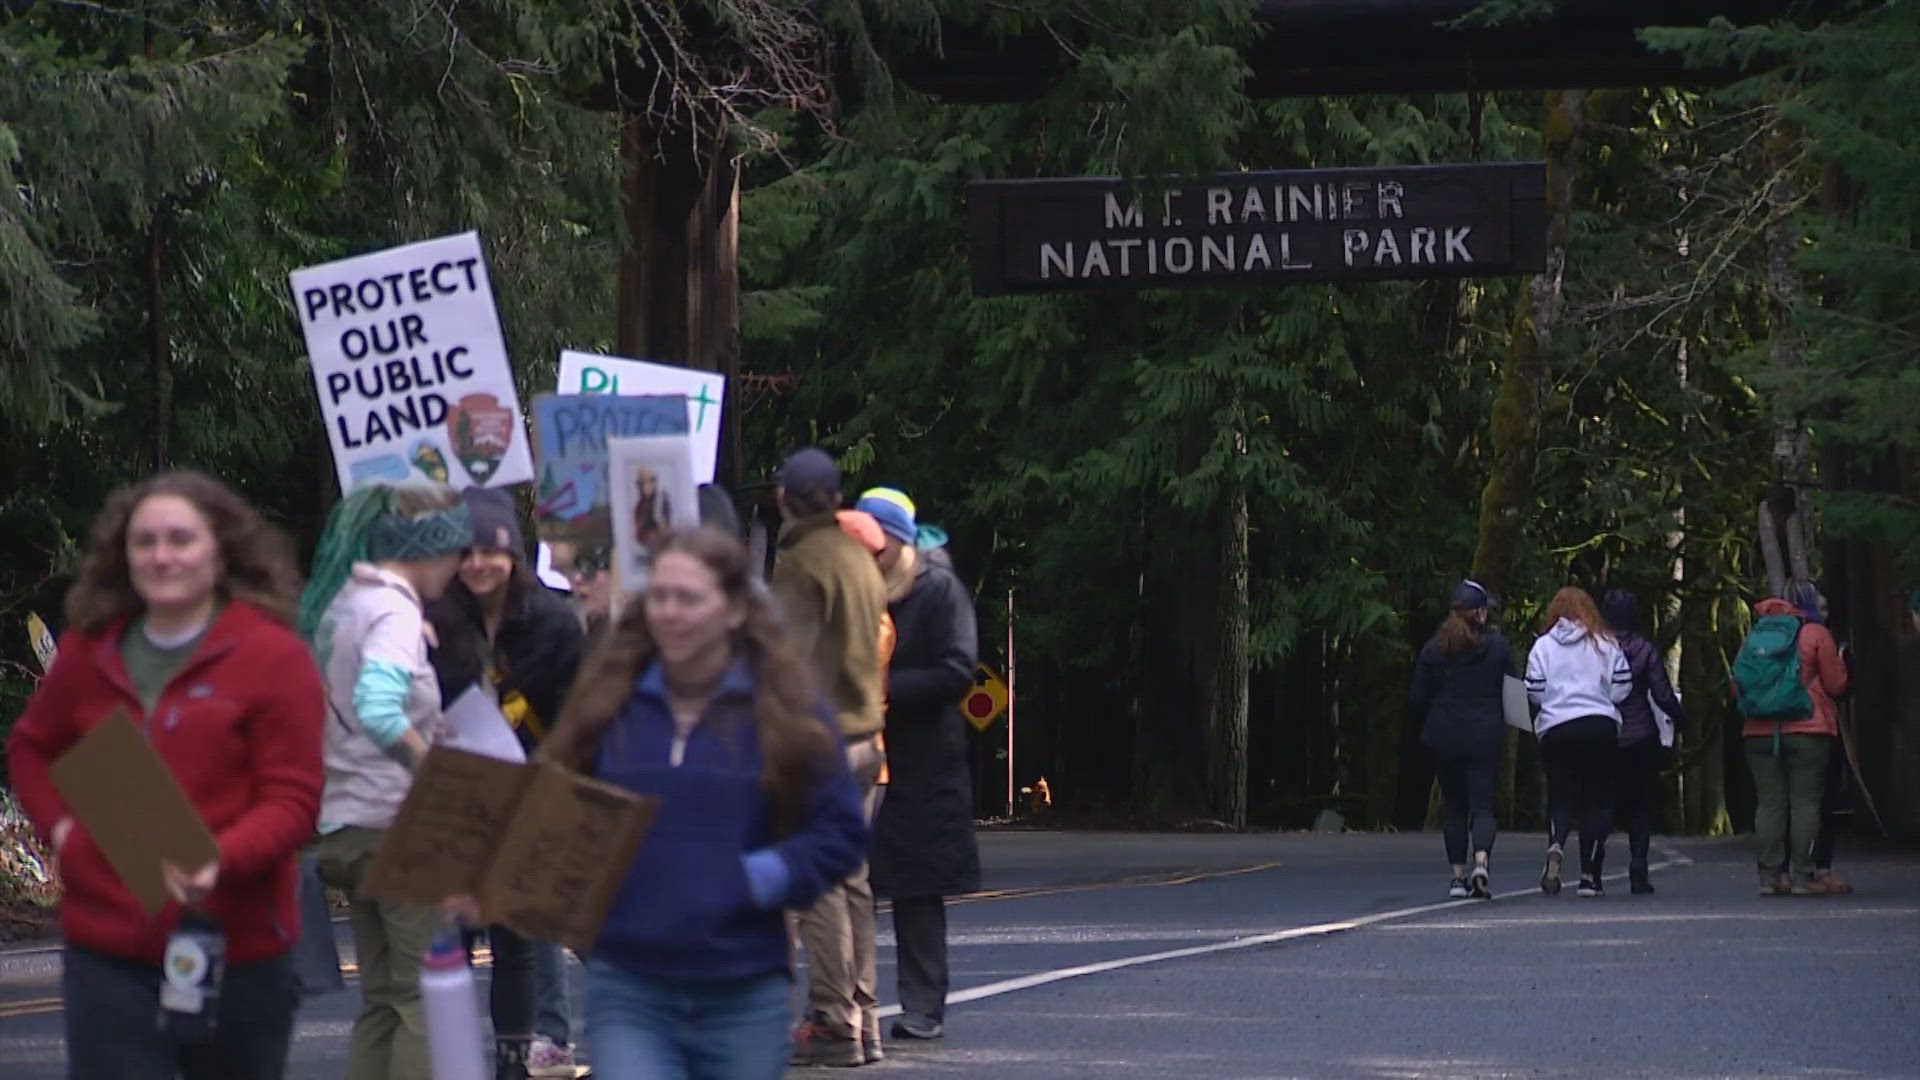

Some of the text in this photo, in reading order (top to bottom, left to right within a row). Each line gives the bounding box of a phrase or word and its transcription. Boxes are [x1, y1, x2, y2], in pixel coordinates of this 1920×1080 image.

[1207, 182, 1404, 226] RAINIER
[1040, 225, 1475, 279] NATIONAL PARK
[304, 258, 478, 322] PROTECT
[340, 313, 429, 361] OUR
[327, 346, 475, 406] PUBLIC
[337, 393, 450, 449] LAND
